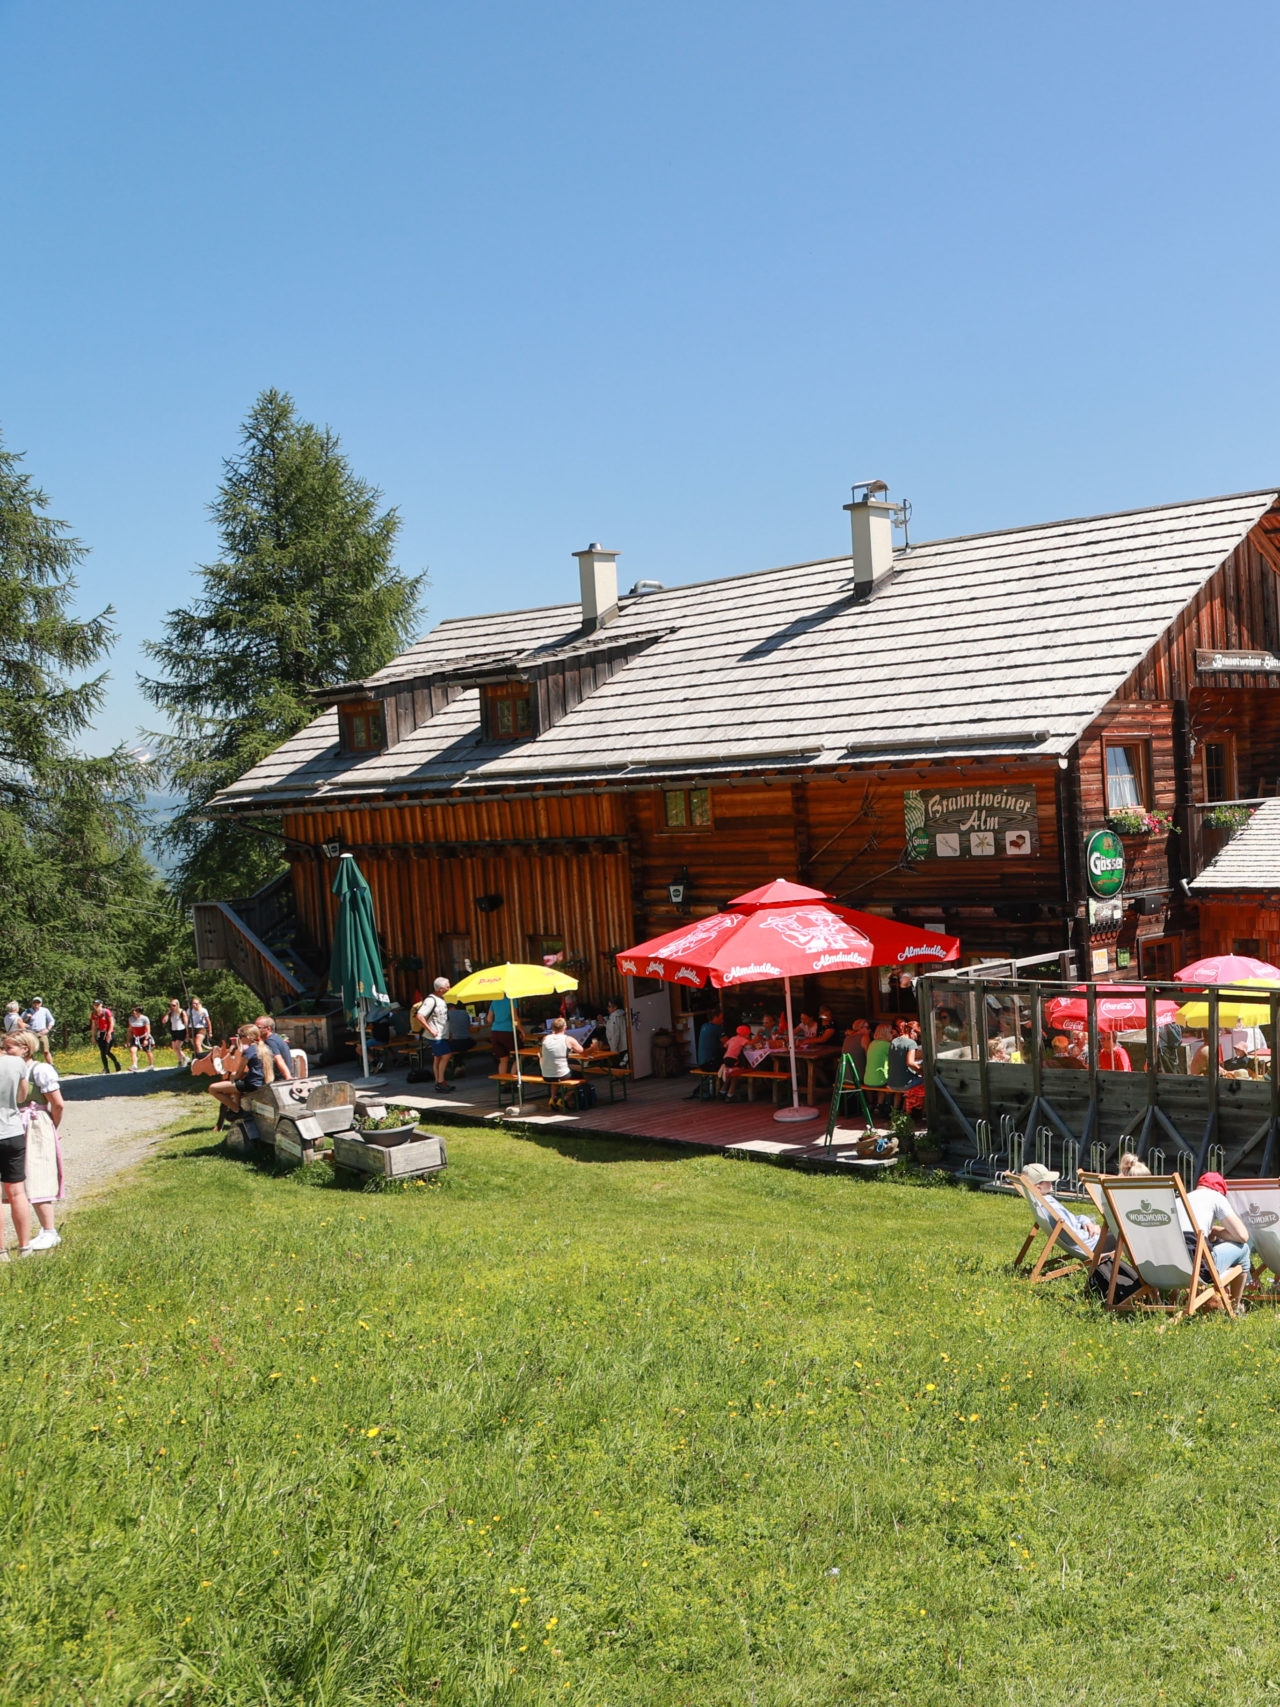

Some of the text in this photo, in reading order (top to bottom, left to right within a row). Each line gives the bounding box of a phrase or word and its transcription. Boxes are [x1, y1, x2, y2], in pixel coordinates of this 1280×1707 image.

[928, 790, 1031, 818] Branntweiner
[960, 809, 999, 831] Alm
[1090, 851, 1123, 876] Gösser
[813, 952, 867, 970] Almdudler
[897, 944, 947, 961] Almdudler
[723, 962, 783, 982] Almdudler
[1102, 1002, 1133, 1010] Coca-Cola
[1063, 1019, 1084, 1030] Coca-Cola
